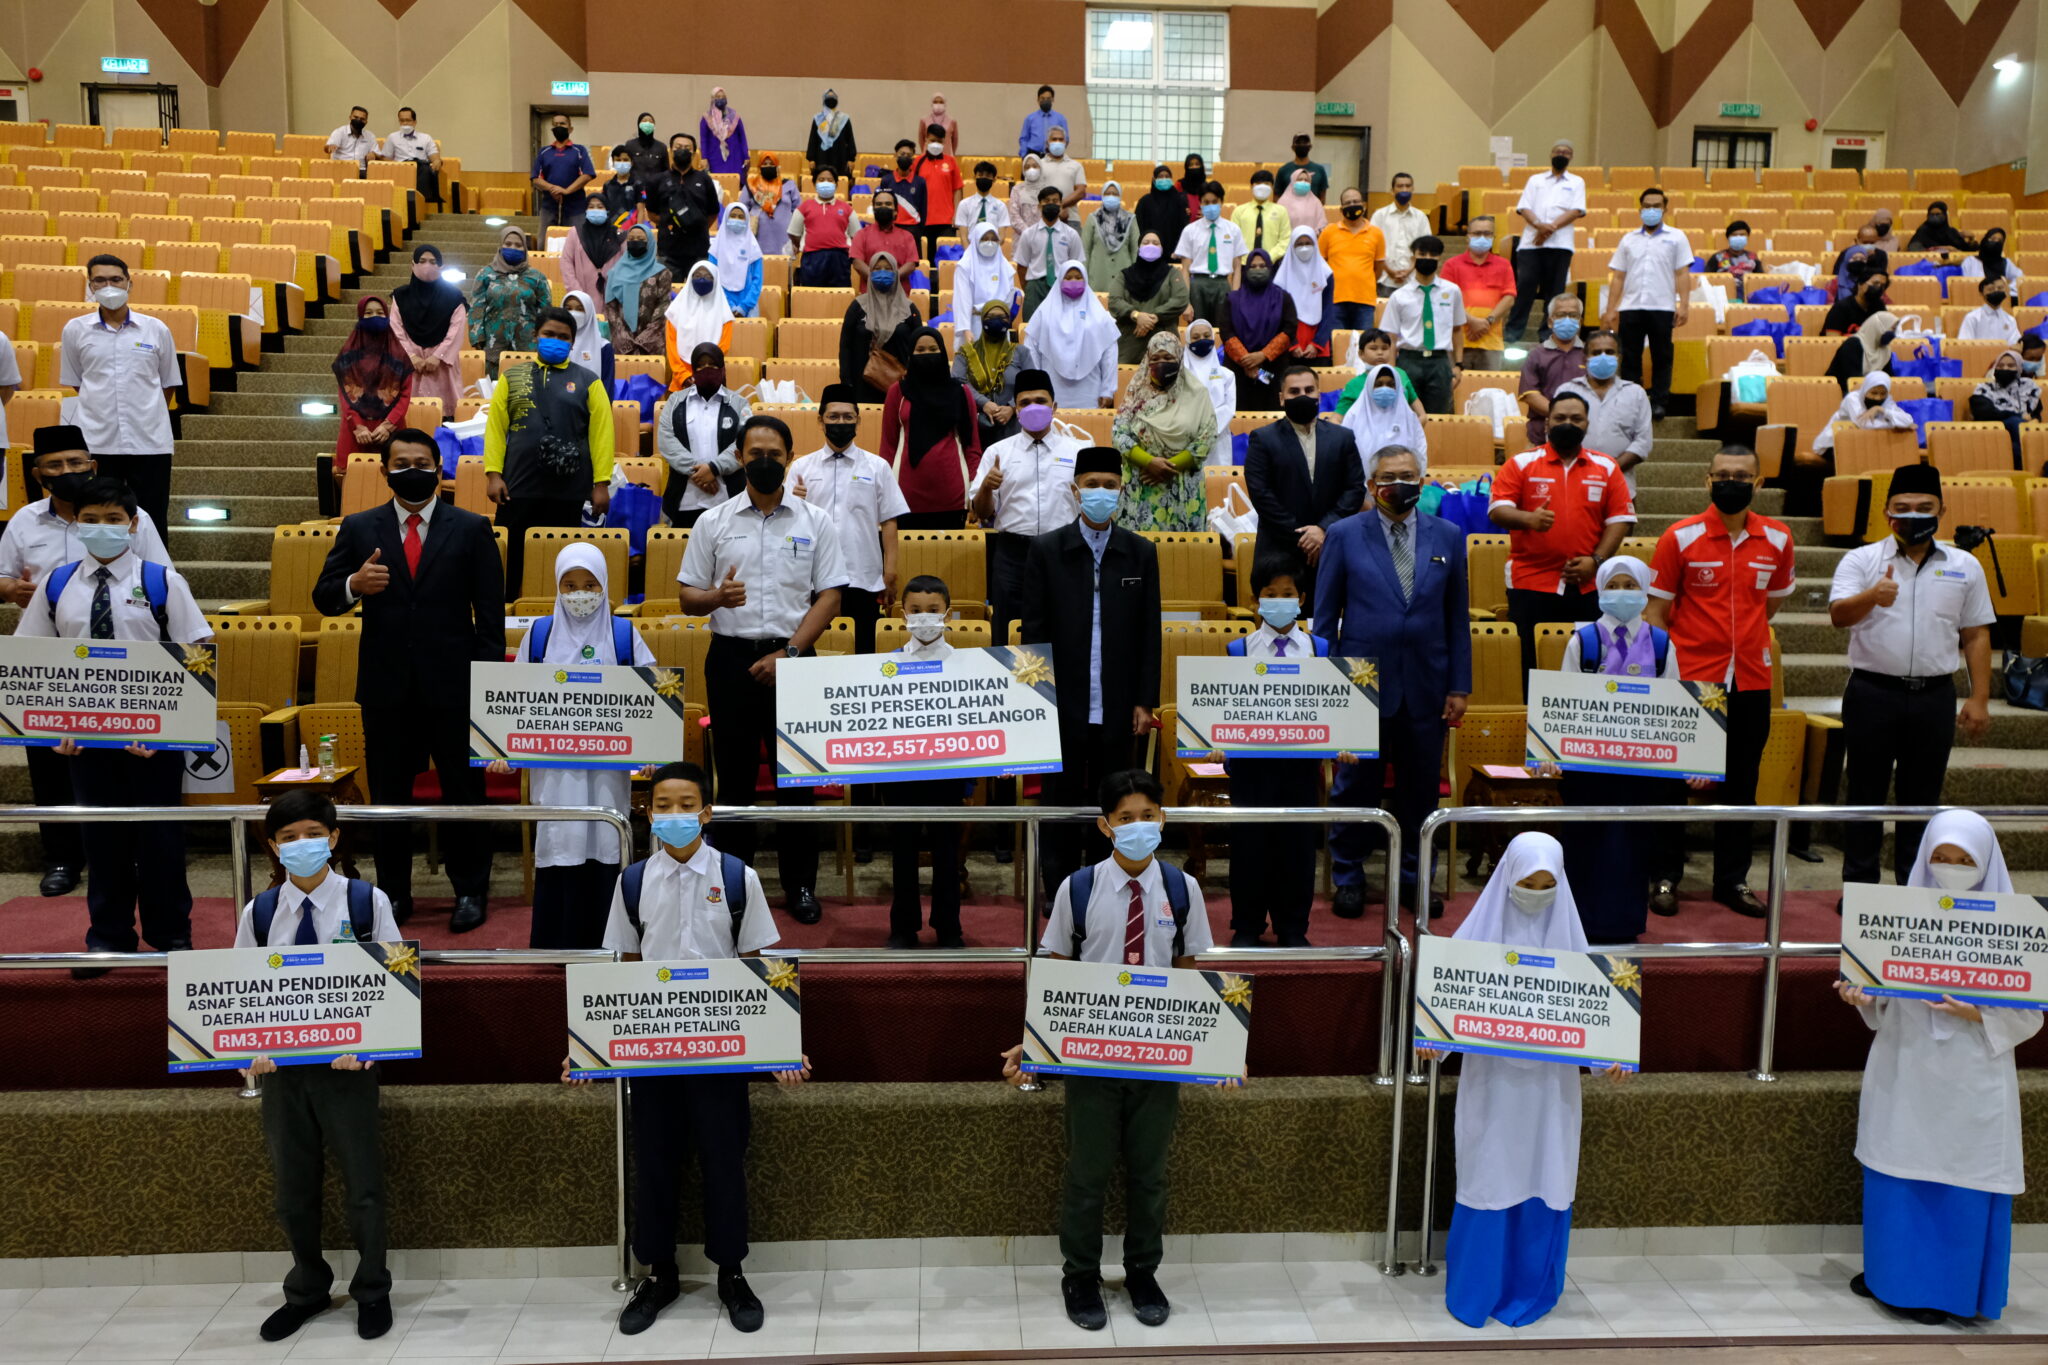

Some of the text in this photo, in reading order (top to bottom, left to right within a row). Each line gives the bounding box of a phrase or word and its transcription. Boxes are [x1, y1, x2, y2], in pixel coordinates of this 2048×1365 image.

[103, 59, 139, 71] KELUAR
[553, 82, 586, 93] KELUAR
[0, 665, 185, 683] BANTUAN PENDIDIKAN
[1, 681, 183, 696] ASNAF SELANGOR SESI 2022
[824, 678, 1008, 699] BANTUAN PENDIDIKAN
[1190, 684, 1350, 696] BANTUAN PENDIDIKAN
[6, 695, 177, 710] DAERAH SABAK BERNAM
[486, 691, 654, 706] BANTUAN PENDIDIKAN
[830, 694, 1004, 715] SESI PERSEKOLAHAN
[1192, 698, 1349, 707] ASNAF SELANGOR SESI 2022
[1542, 697, 1699, 718] BANTUAN PENDIDIKAN
[486, 705, 653, 718] ASNAF SELANGOR SESI 2022
[785, 708, 1046, 734] TAHUN 2022 NEGERI SELANGOR
[1224, 711, 1317, 721] DAERAH KLANG
[1543, 711, 1697, 730] ASNAF SELANGOR SESI 2022
[28, 715, 155, 731] RM2,146,490.00
[517, 720, 623, 732] DAERAH SEPANG
[1216, 728, 1325, 742] RM6,499,950.00
[1544, 723, 1695, 743] DAERAH HULU SELANGOR
[512, 738, 627, 752] RM1,102,950.00
[832, 735, 999, 759] RM32,557,590.00
[1565, 741, 1673, 759] RM3,148,730.00
[1859, 914, 2048, 939] BANTUAN PENDIDIKA
[1860, 930, 2048, 953] ASNAF SELANGOR SESI 202
[1891, 946, 2023, 966] DAERAH GOMBAK
[186, 974, 386, 997] BANTUAN PENDIDIKAN
[1434, 967, 1610, 998] BANTUAN PENDIDIKAN
[1888, 965, 2025, 987] RM3,549,740.00
[188, 990, 384, 1010] ASNAF SELANGOR SESI 2022
[583, 989, 767, 1007] BANTUAN PENDIDIKAN
[1044, 990, 1220, 1014] BANTUAN PENDIDIKAN
[1434, 983, 1608, 1011] ASNAF SELANGOR SESI 2022
[203, 1006, 372, 1026] DAERAH HULU LANGAT
[586, 1005, 766, 1021] ASNAF SELANGOR SESI 2022
[1044, 1006, 1217, 1027] ASNAF SELANGOR SESI 2022
[1431, 997, 1610, 1026] DAERAH KUALA SELANGOR
[613, 1020, 740, 1035] DAERAH PETALING
[1050, 1021, 1208, 1042] DAERAH KUALA LANGAT
[1458, 1019, 1580, 1044] RM3,928,400.00
[219, 1027, 355, 1048] RM3,713,680.00
[614, 1040, 739, 1057] RM6,374,930.00
[1066, 1042, 1187, 1061] RM2,092,720.00
